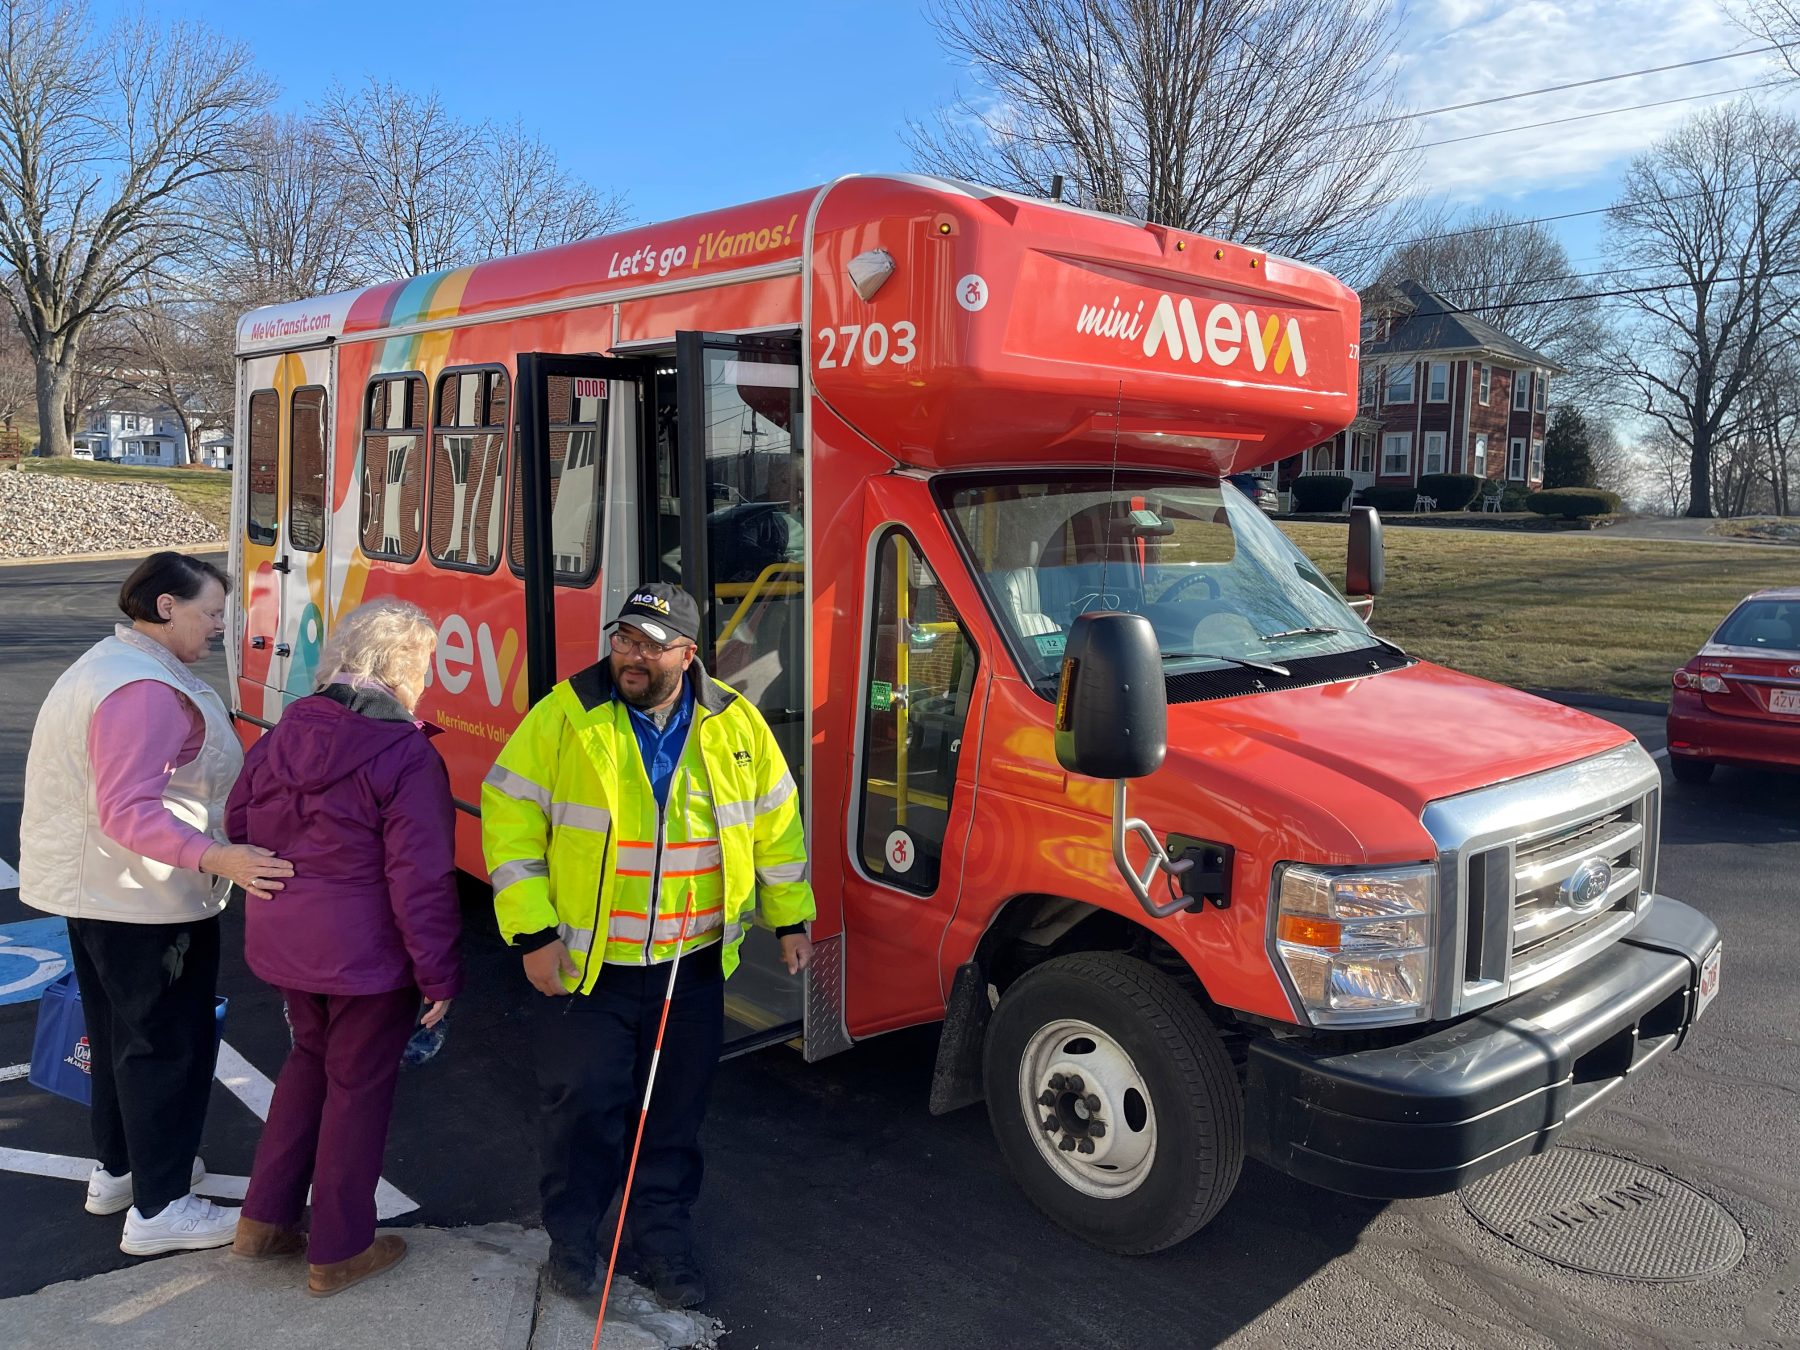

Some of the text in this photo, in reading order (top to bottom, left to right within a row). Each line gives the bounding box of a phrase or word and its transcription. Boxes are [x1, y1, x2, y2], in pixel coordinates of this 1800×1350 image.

[607, 214, 799, 279] Let's go ¡Vamos!
[251, 313, 331, 341] MeVaTransit.com
[1076, 295, 1144, 342] mini
[818, 320, 917, 369] 2703
[577, 379, 606, 398] DOOR
[436, 709, 512, 744] Merrimack Valle
[1524, 1182, 1666, 1236] DRAIN
